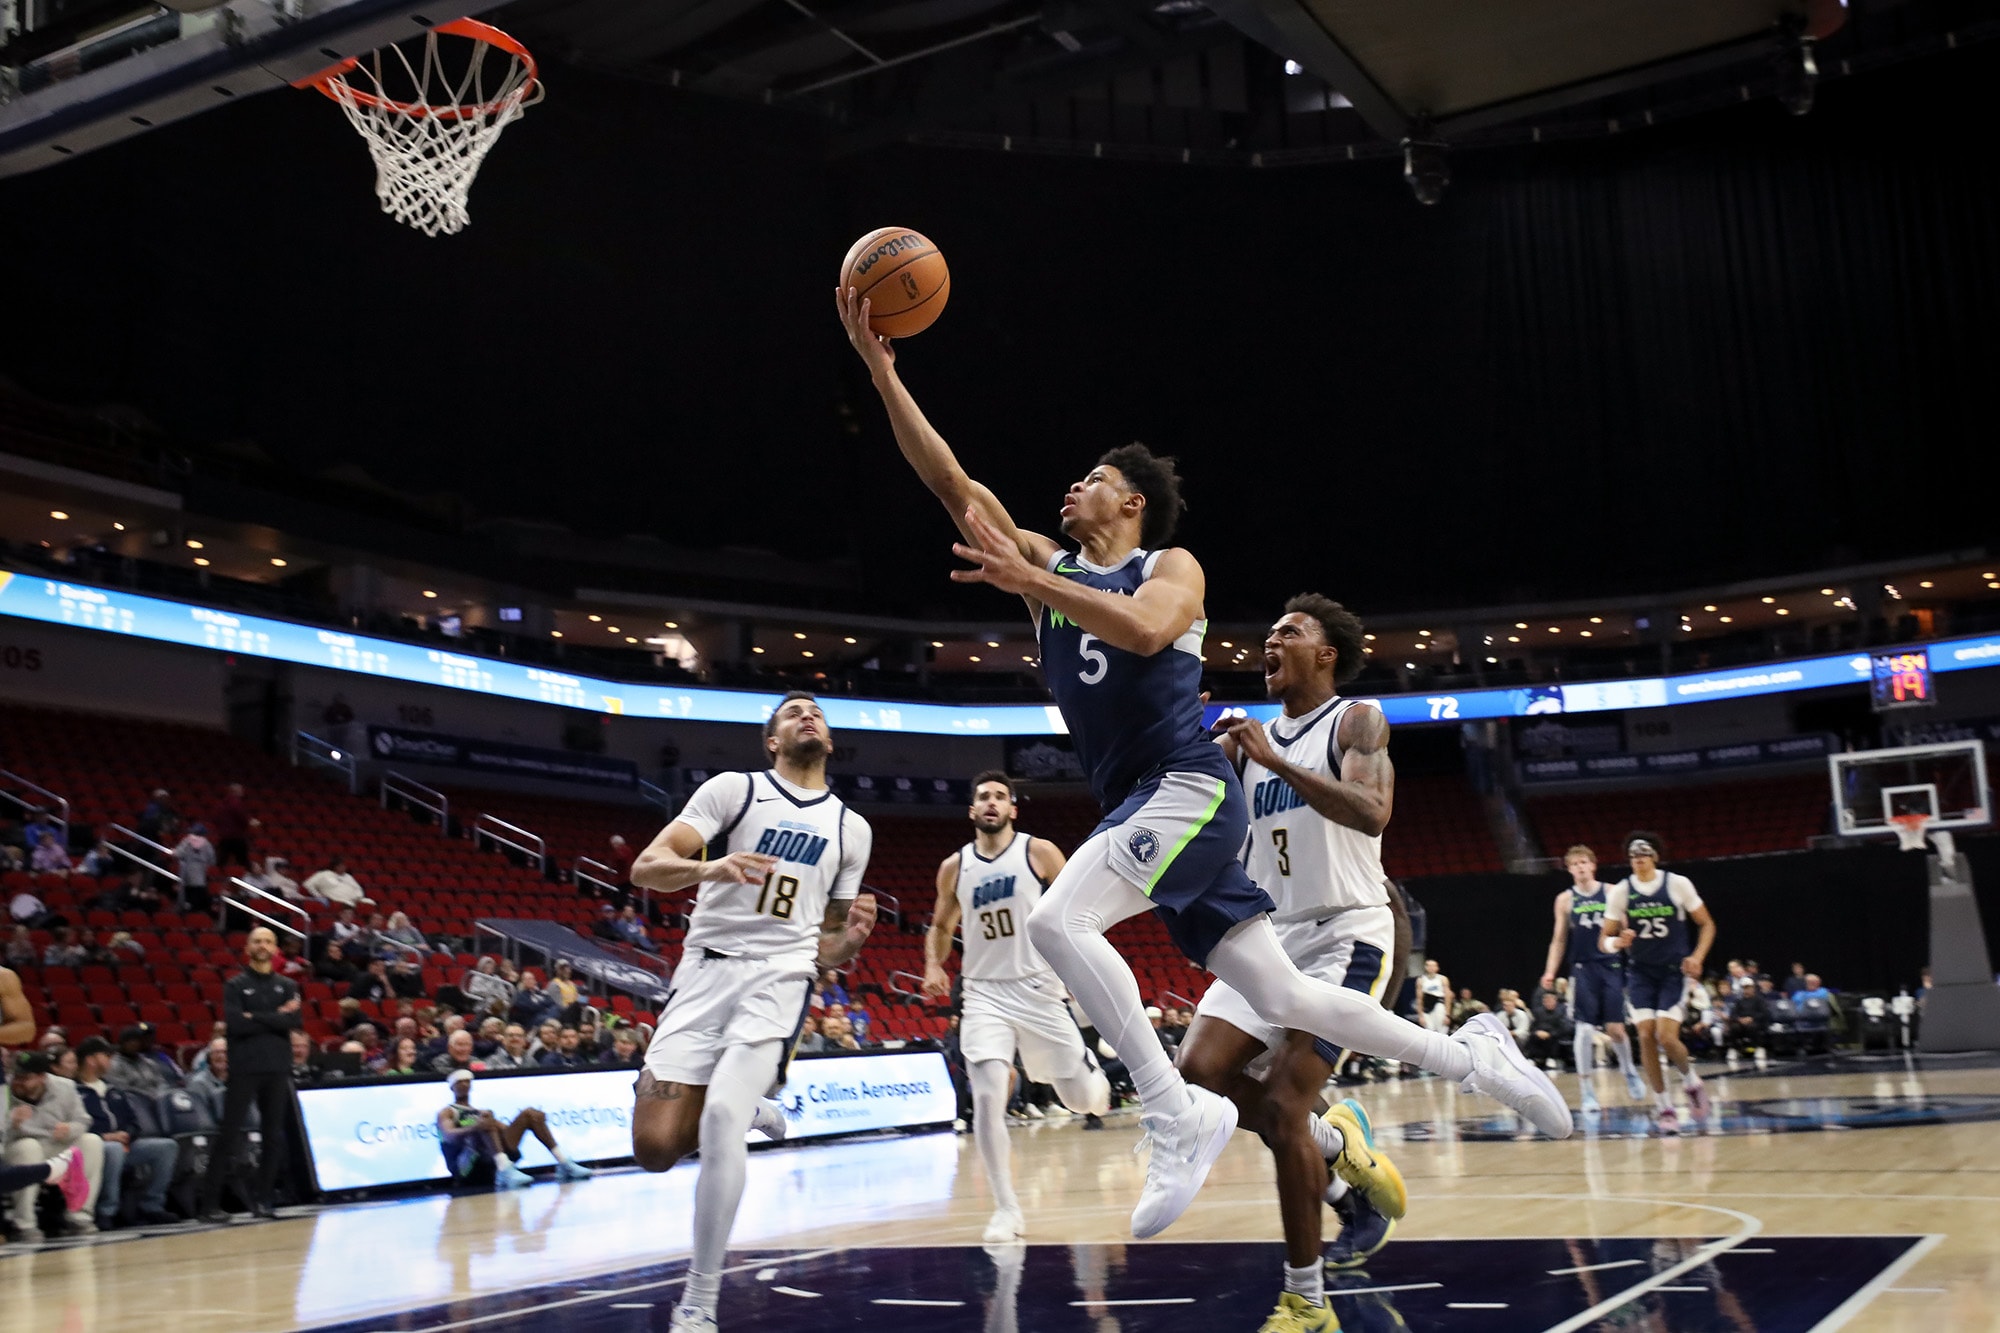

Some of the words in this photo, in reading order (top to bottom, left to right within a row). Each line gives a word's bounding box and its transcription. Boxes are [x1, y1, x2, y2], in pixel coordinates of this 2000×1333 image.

[857, 235, 925, 275] Wilson
[0, 645, 41, 672] 05
[1079, 633, 1108, 685] 5
[1427, 697, 1460, 719] 72
[755, 828, 829, 866] BOOM
[1271, 828, 1291, 877] 3
[756, 872, 799, 920] 18
[980, 908, 1016, 940] 30
[1637, 917, 1670, 939] 25
[808, 1081, 858, 1103] Collins
[862, 1080, 931, 1100] Aerospace
[354, 1120, 440, 1145] Connec
